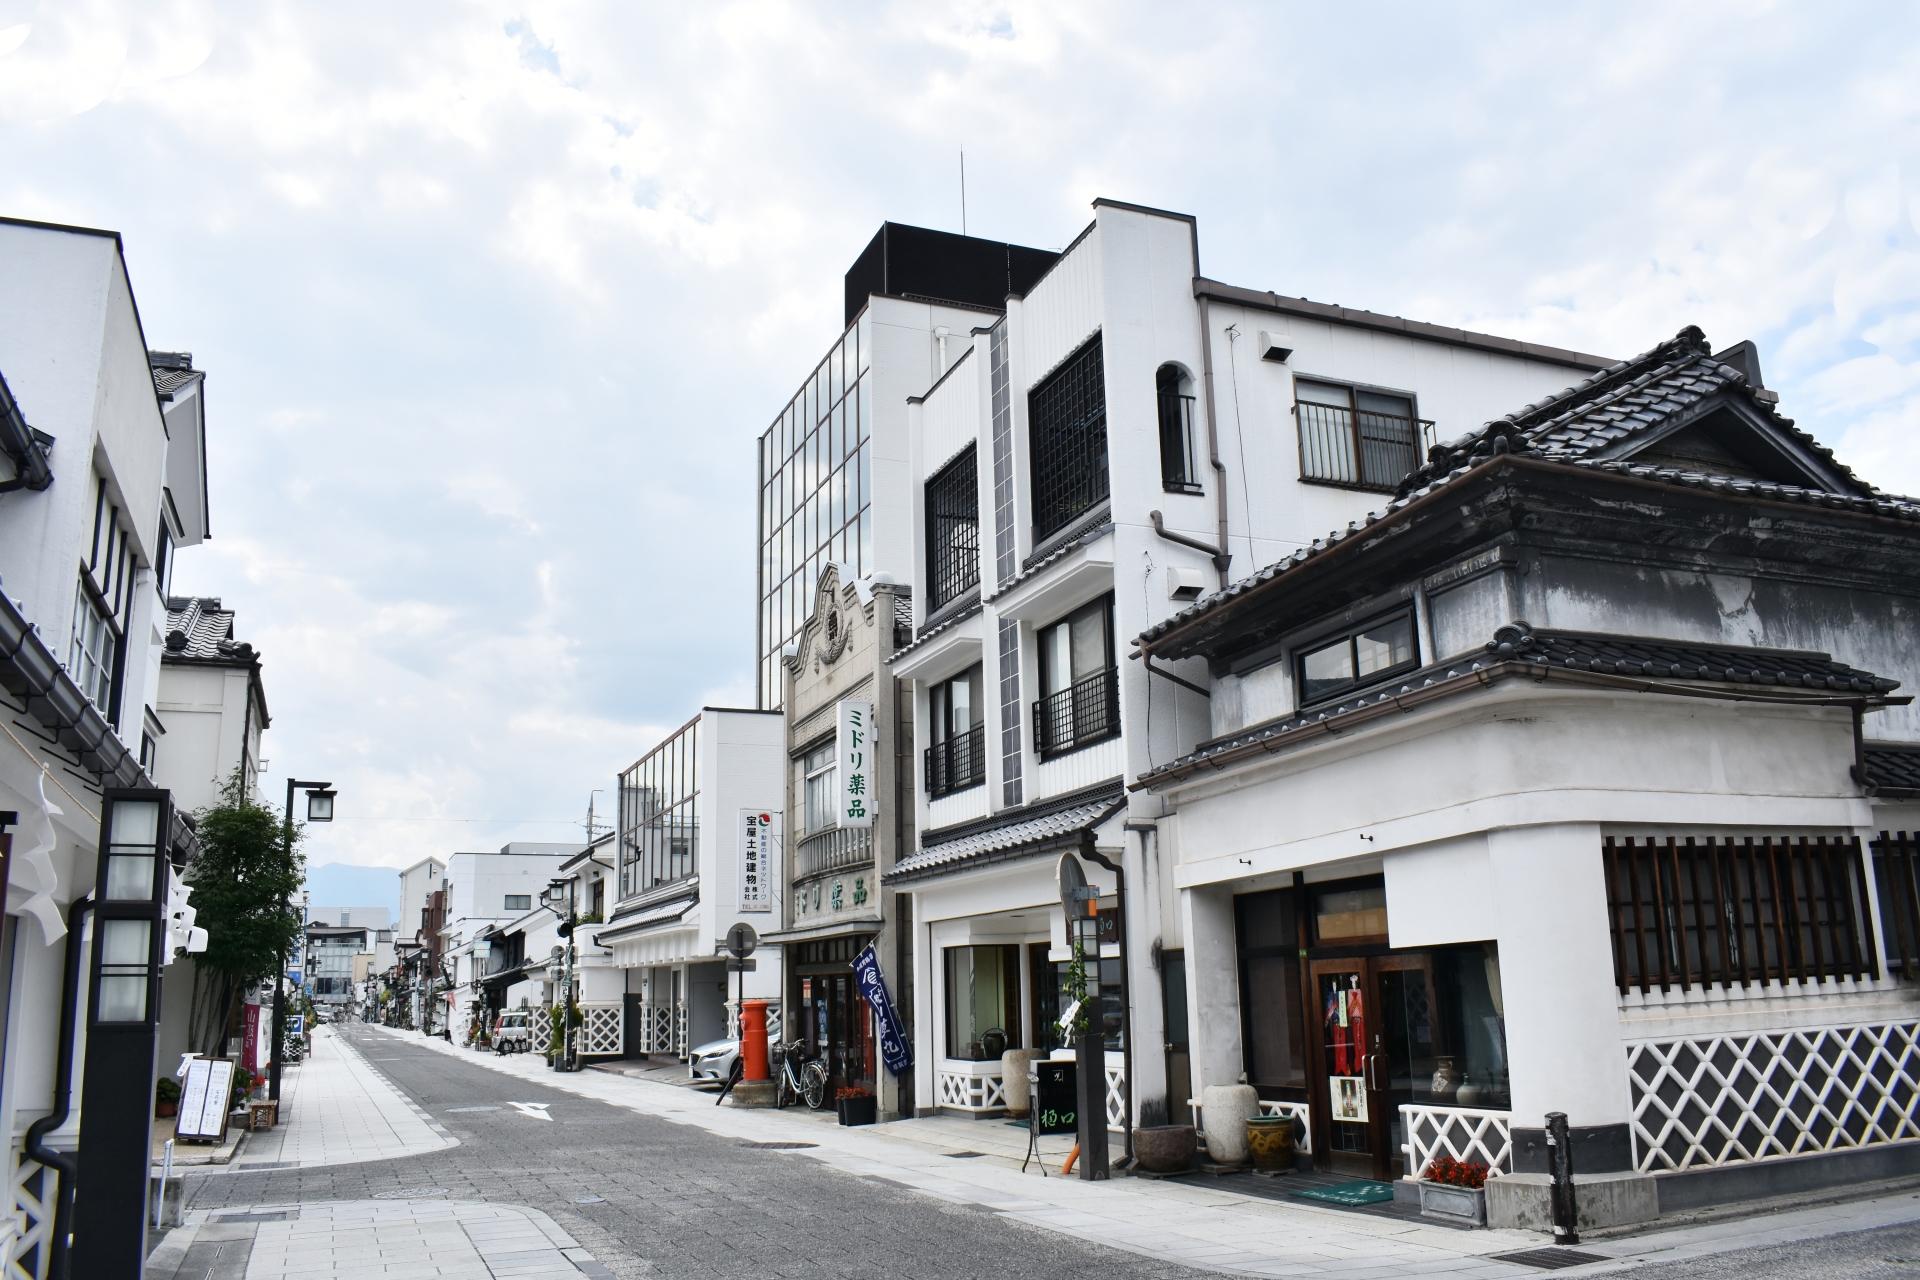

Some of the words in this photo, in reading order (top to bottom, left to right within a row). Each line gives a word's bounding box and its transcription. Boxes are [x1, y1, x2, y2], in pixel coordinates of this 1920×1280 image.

[847, 709, 867, 819] ミドリ薬品
[746, 815, 757, 885] 宝屋土地建物
[1041, 1109, 1075, 1128] 樋口
